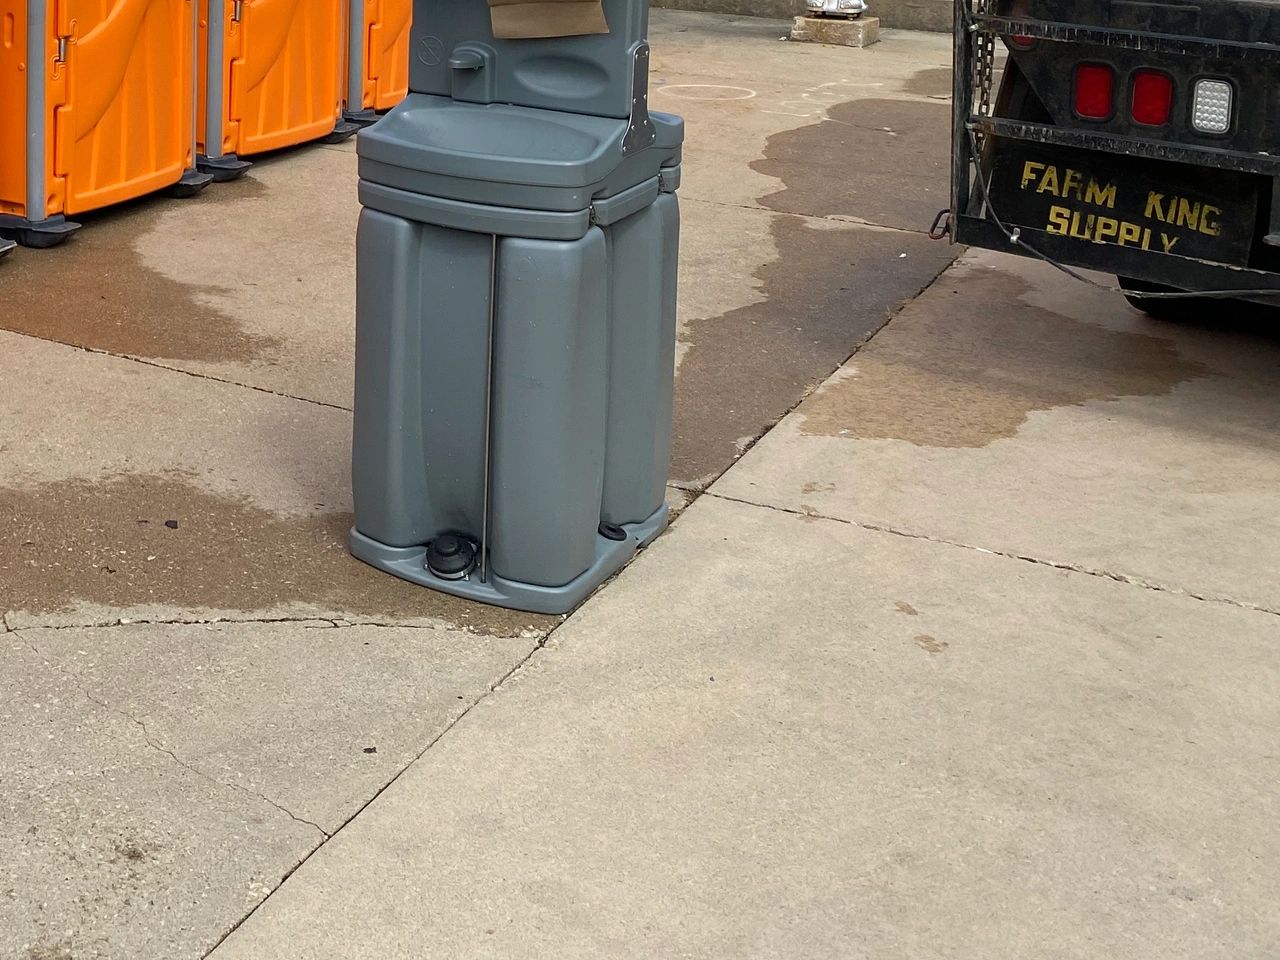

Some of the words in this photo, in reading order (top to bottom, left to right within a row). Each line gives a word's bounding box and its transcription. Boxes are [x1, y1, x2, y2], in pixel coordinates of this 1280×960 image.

[1020, 161, 1117, 209] FARM
[1144, 191, 1223, 236] KING
[1046, 205, 1180, 255] SUPPLY
